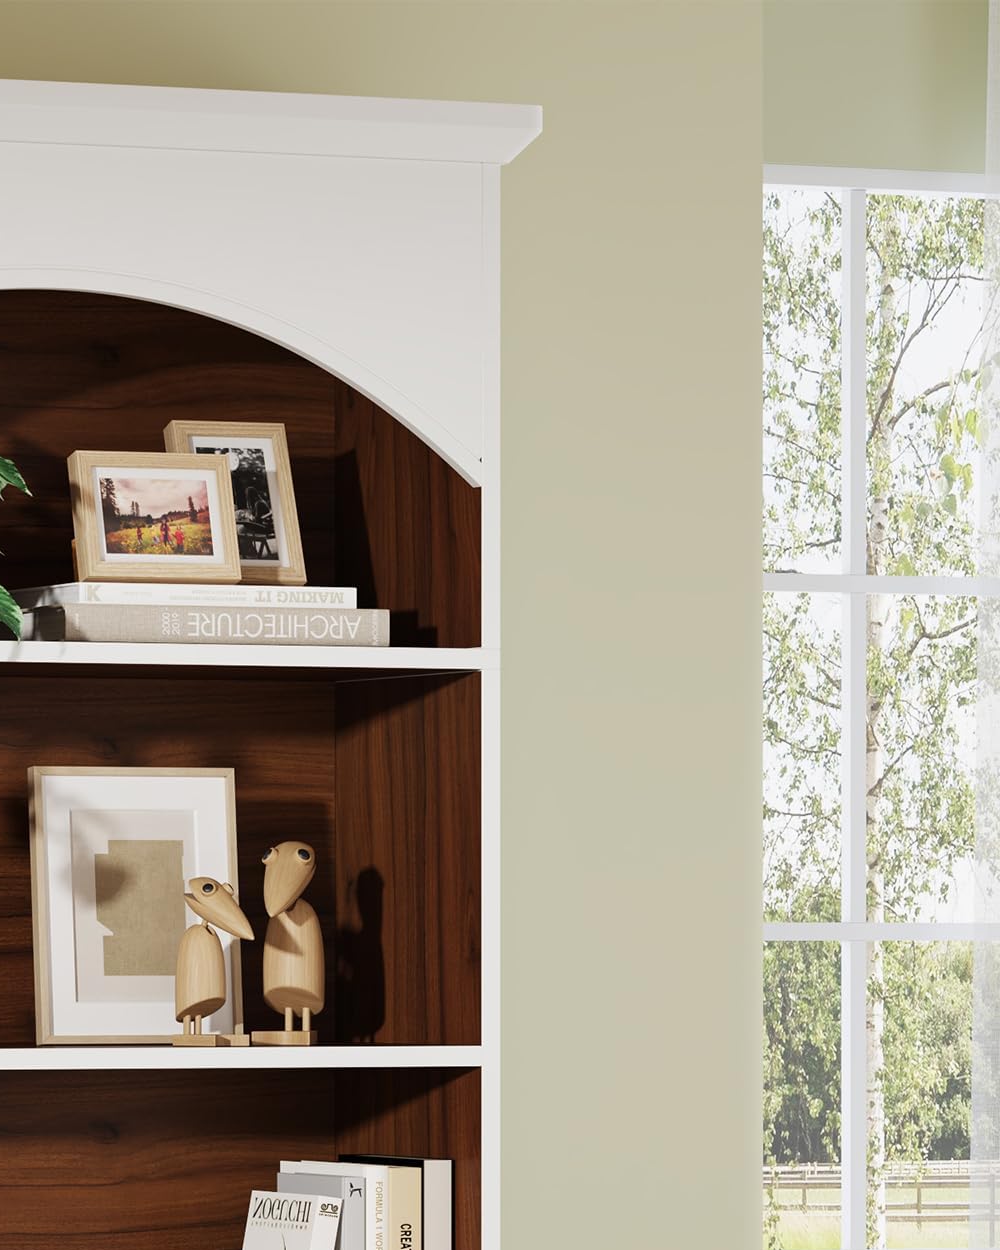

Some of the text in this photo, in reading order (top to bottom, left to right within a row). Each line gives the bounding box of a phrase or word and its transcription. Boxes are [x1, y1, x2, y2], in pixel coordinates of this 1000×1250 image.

[254, 590, 273, 603] IT
[277, 590, 344, 604] MAKING
[187, 612, 361, 640] ARCHITECTURE
[374, 1181, 384, 1223] FORMULA
